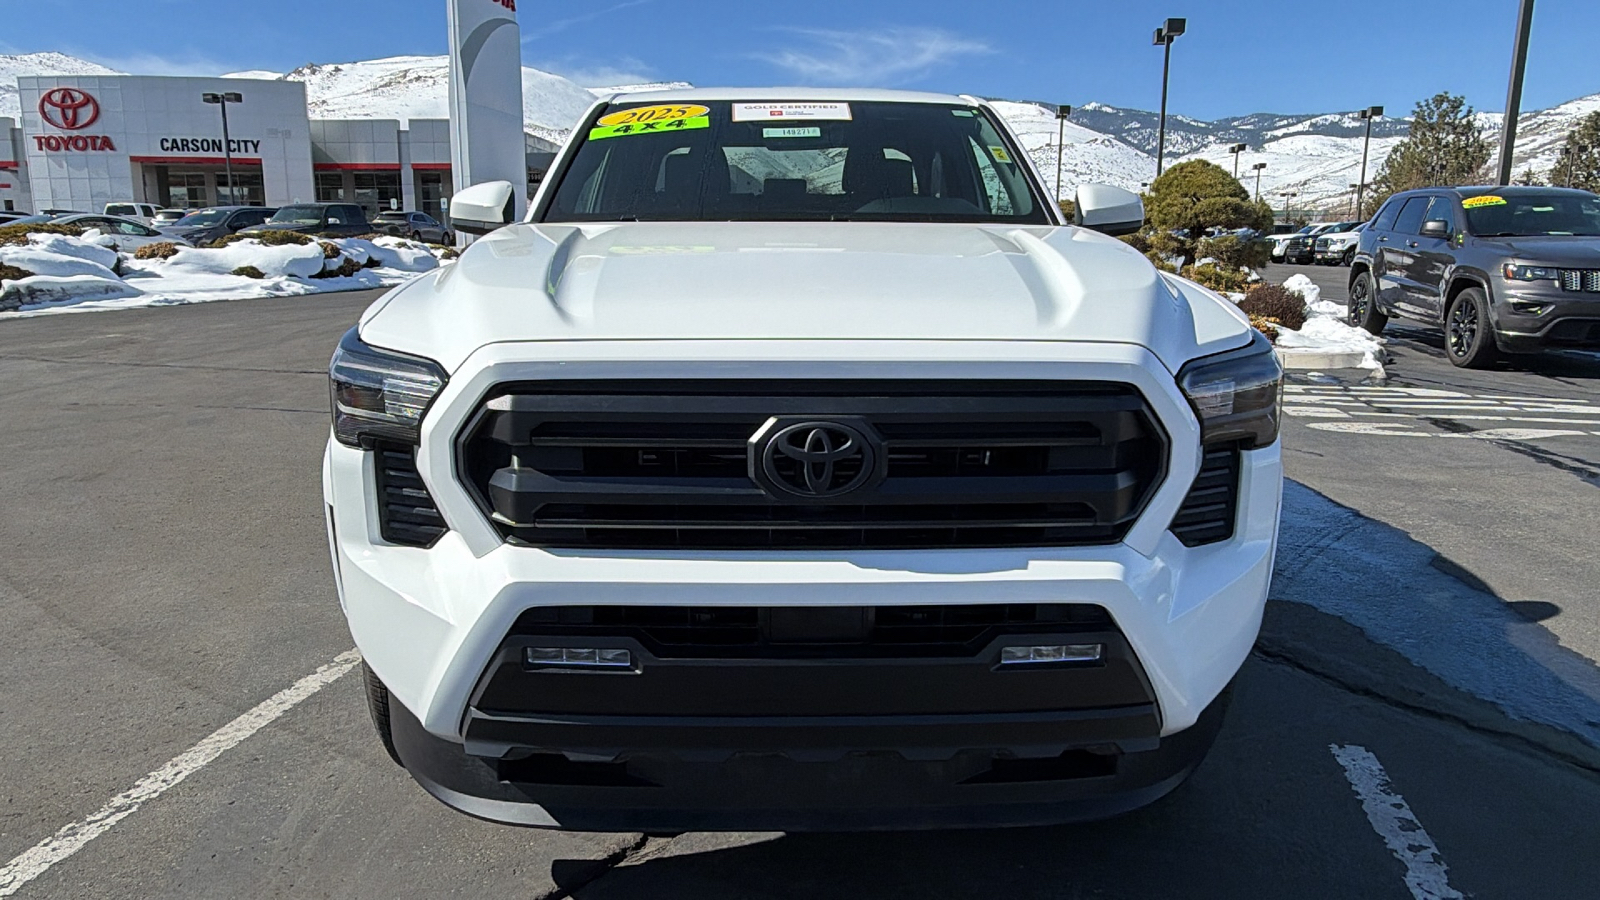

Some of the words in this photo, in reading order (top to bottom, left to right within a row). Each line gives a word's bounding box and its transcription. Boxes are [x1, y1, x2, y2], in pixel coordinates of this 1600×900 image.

[616, 106, 692, 125] 2025
[33, 135, 116, 152] TOYOTA
[160, 137, 222, 153] CARSON
[227, 139, 260, 153] CITY
